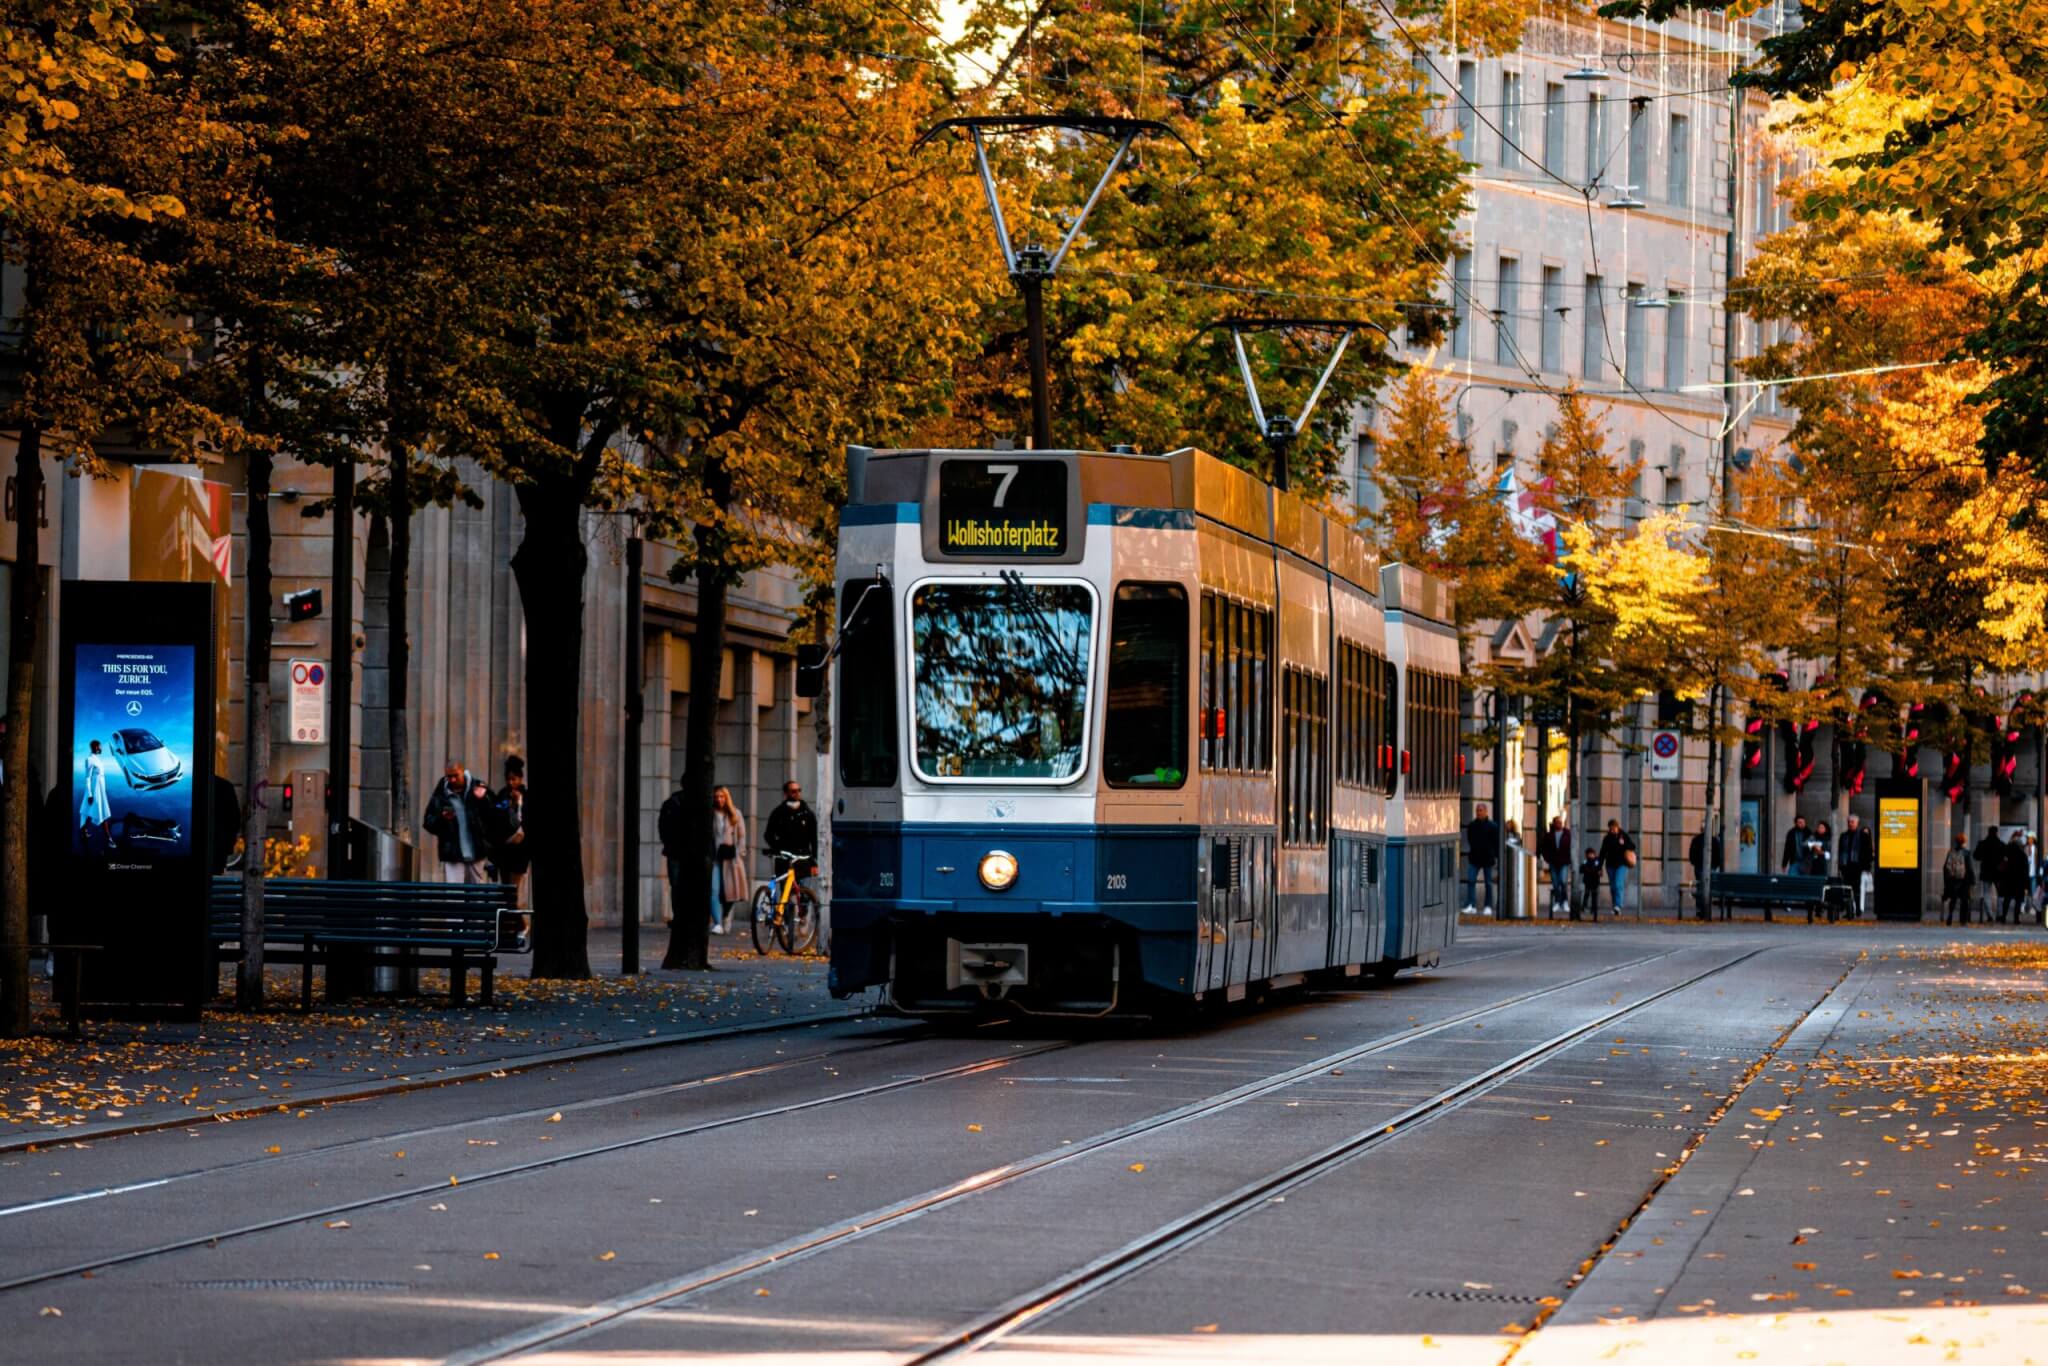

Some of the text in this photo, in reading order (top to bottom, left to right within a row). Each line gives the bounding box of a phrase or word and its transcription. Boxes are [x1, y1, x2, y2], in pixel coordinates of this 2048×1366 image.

[986, 464, 1019, 508] 7
[948, 519, 1058, 552] Wollishoferplatz
[102, 664, 168, 675] THIS IS FOR YOU,
[880, 872, 894, 887] 2103
[1106, 873, 1127, 890] 2103
